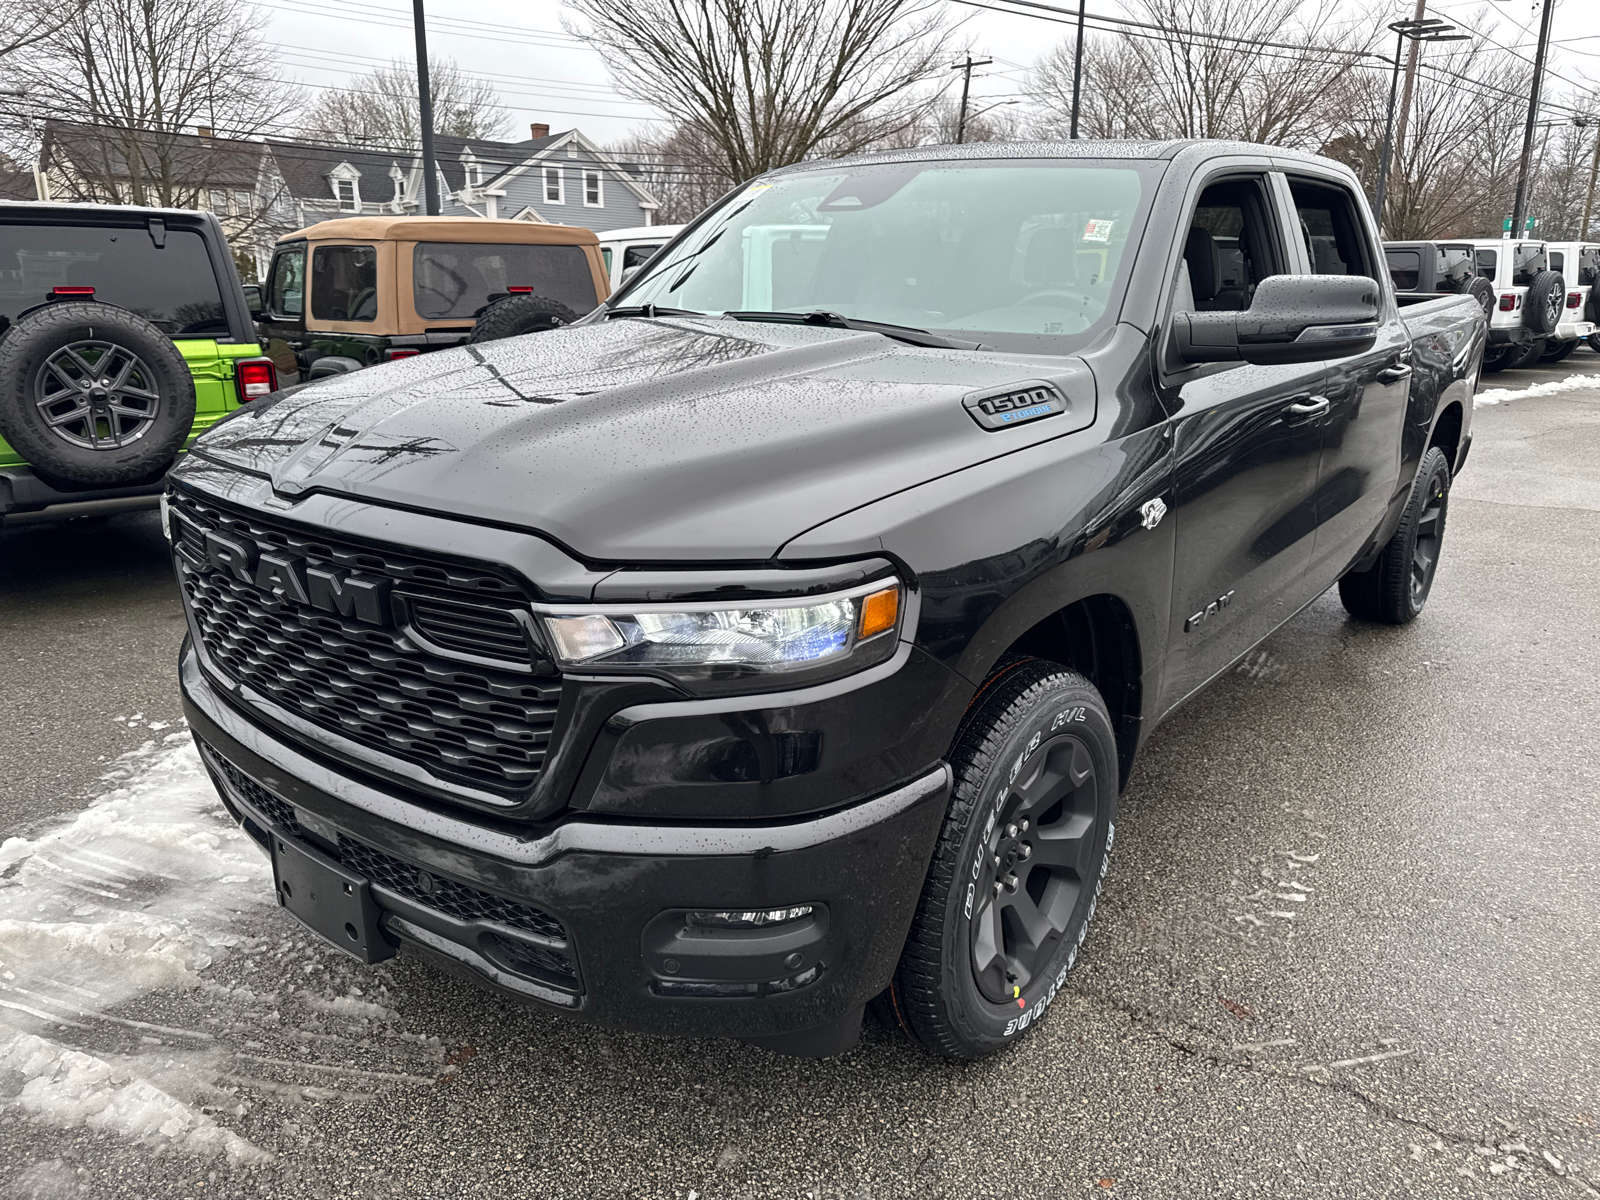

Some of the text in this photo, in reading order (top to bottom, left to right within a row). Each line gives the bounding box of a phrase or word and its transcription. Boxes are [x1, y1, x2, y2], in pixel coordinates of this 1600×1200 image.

[981, 388, 1050, 414] 1500
[205, 529, 386, 626] RAM
[1183, 590, 1235, 633] RAM
[964, 707, 1087, 920] DUELER H/L
[1002, 820, 1116, 1036] BRIDGESTONE
